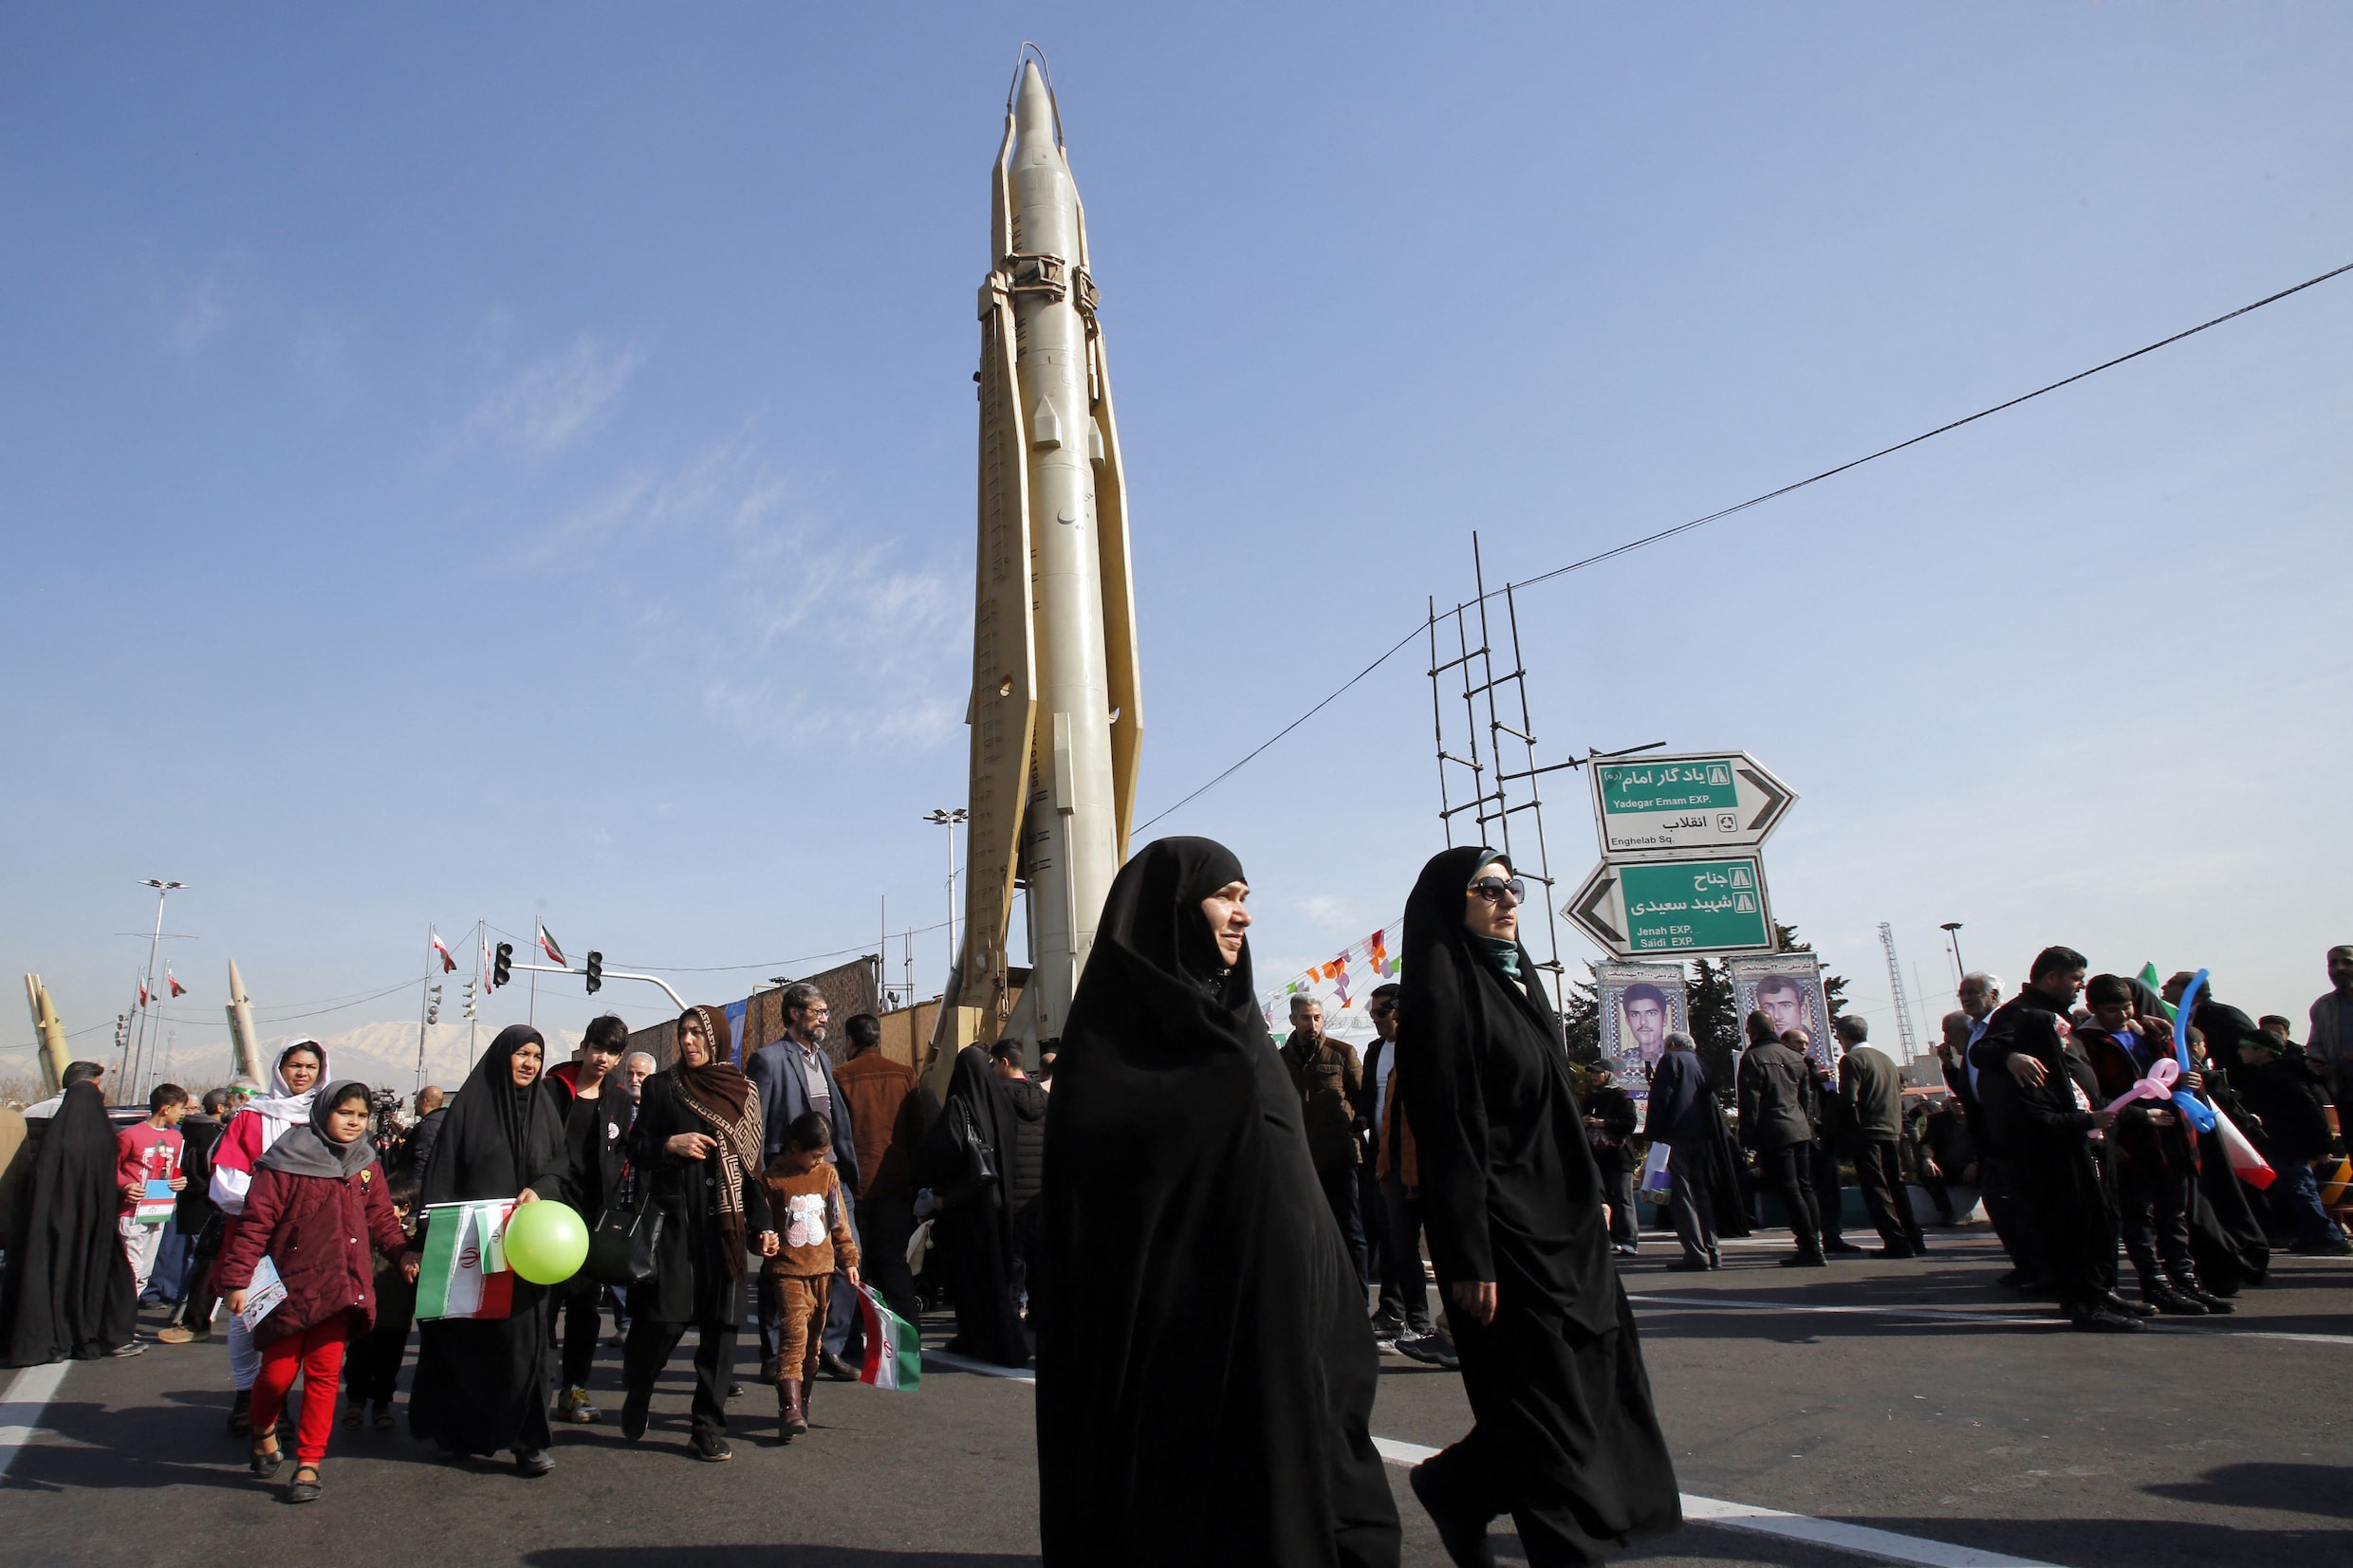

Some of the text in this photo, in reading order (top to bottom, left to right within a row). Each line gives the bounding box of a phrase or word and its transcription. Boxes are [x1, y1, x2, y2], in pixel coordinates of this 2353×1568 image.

[1622, 770, 1653, 793] امام
[1613, 795, 1712, 809] Yadegar Emam EXP.
[1662, 816, 1707, 832] انقلاب
[1611, 836, 1675, 846] Enghelab Sq.
[1694, 871, 1729, 892] جناح
[1630, 895, 1732, 916] شهید سعیدی
[1637, 925, 1693, 936] Jenah EXP.
[1671, 936, 1695, 947] EXP.
